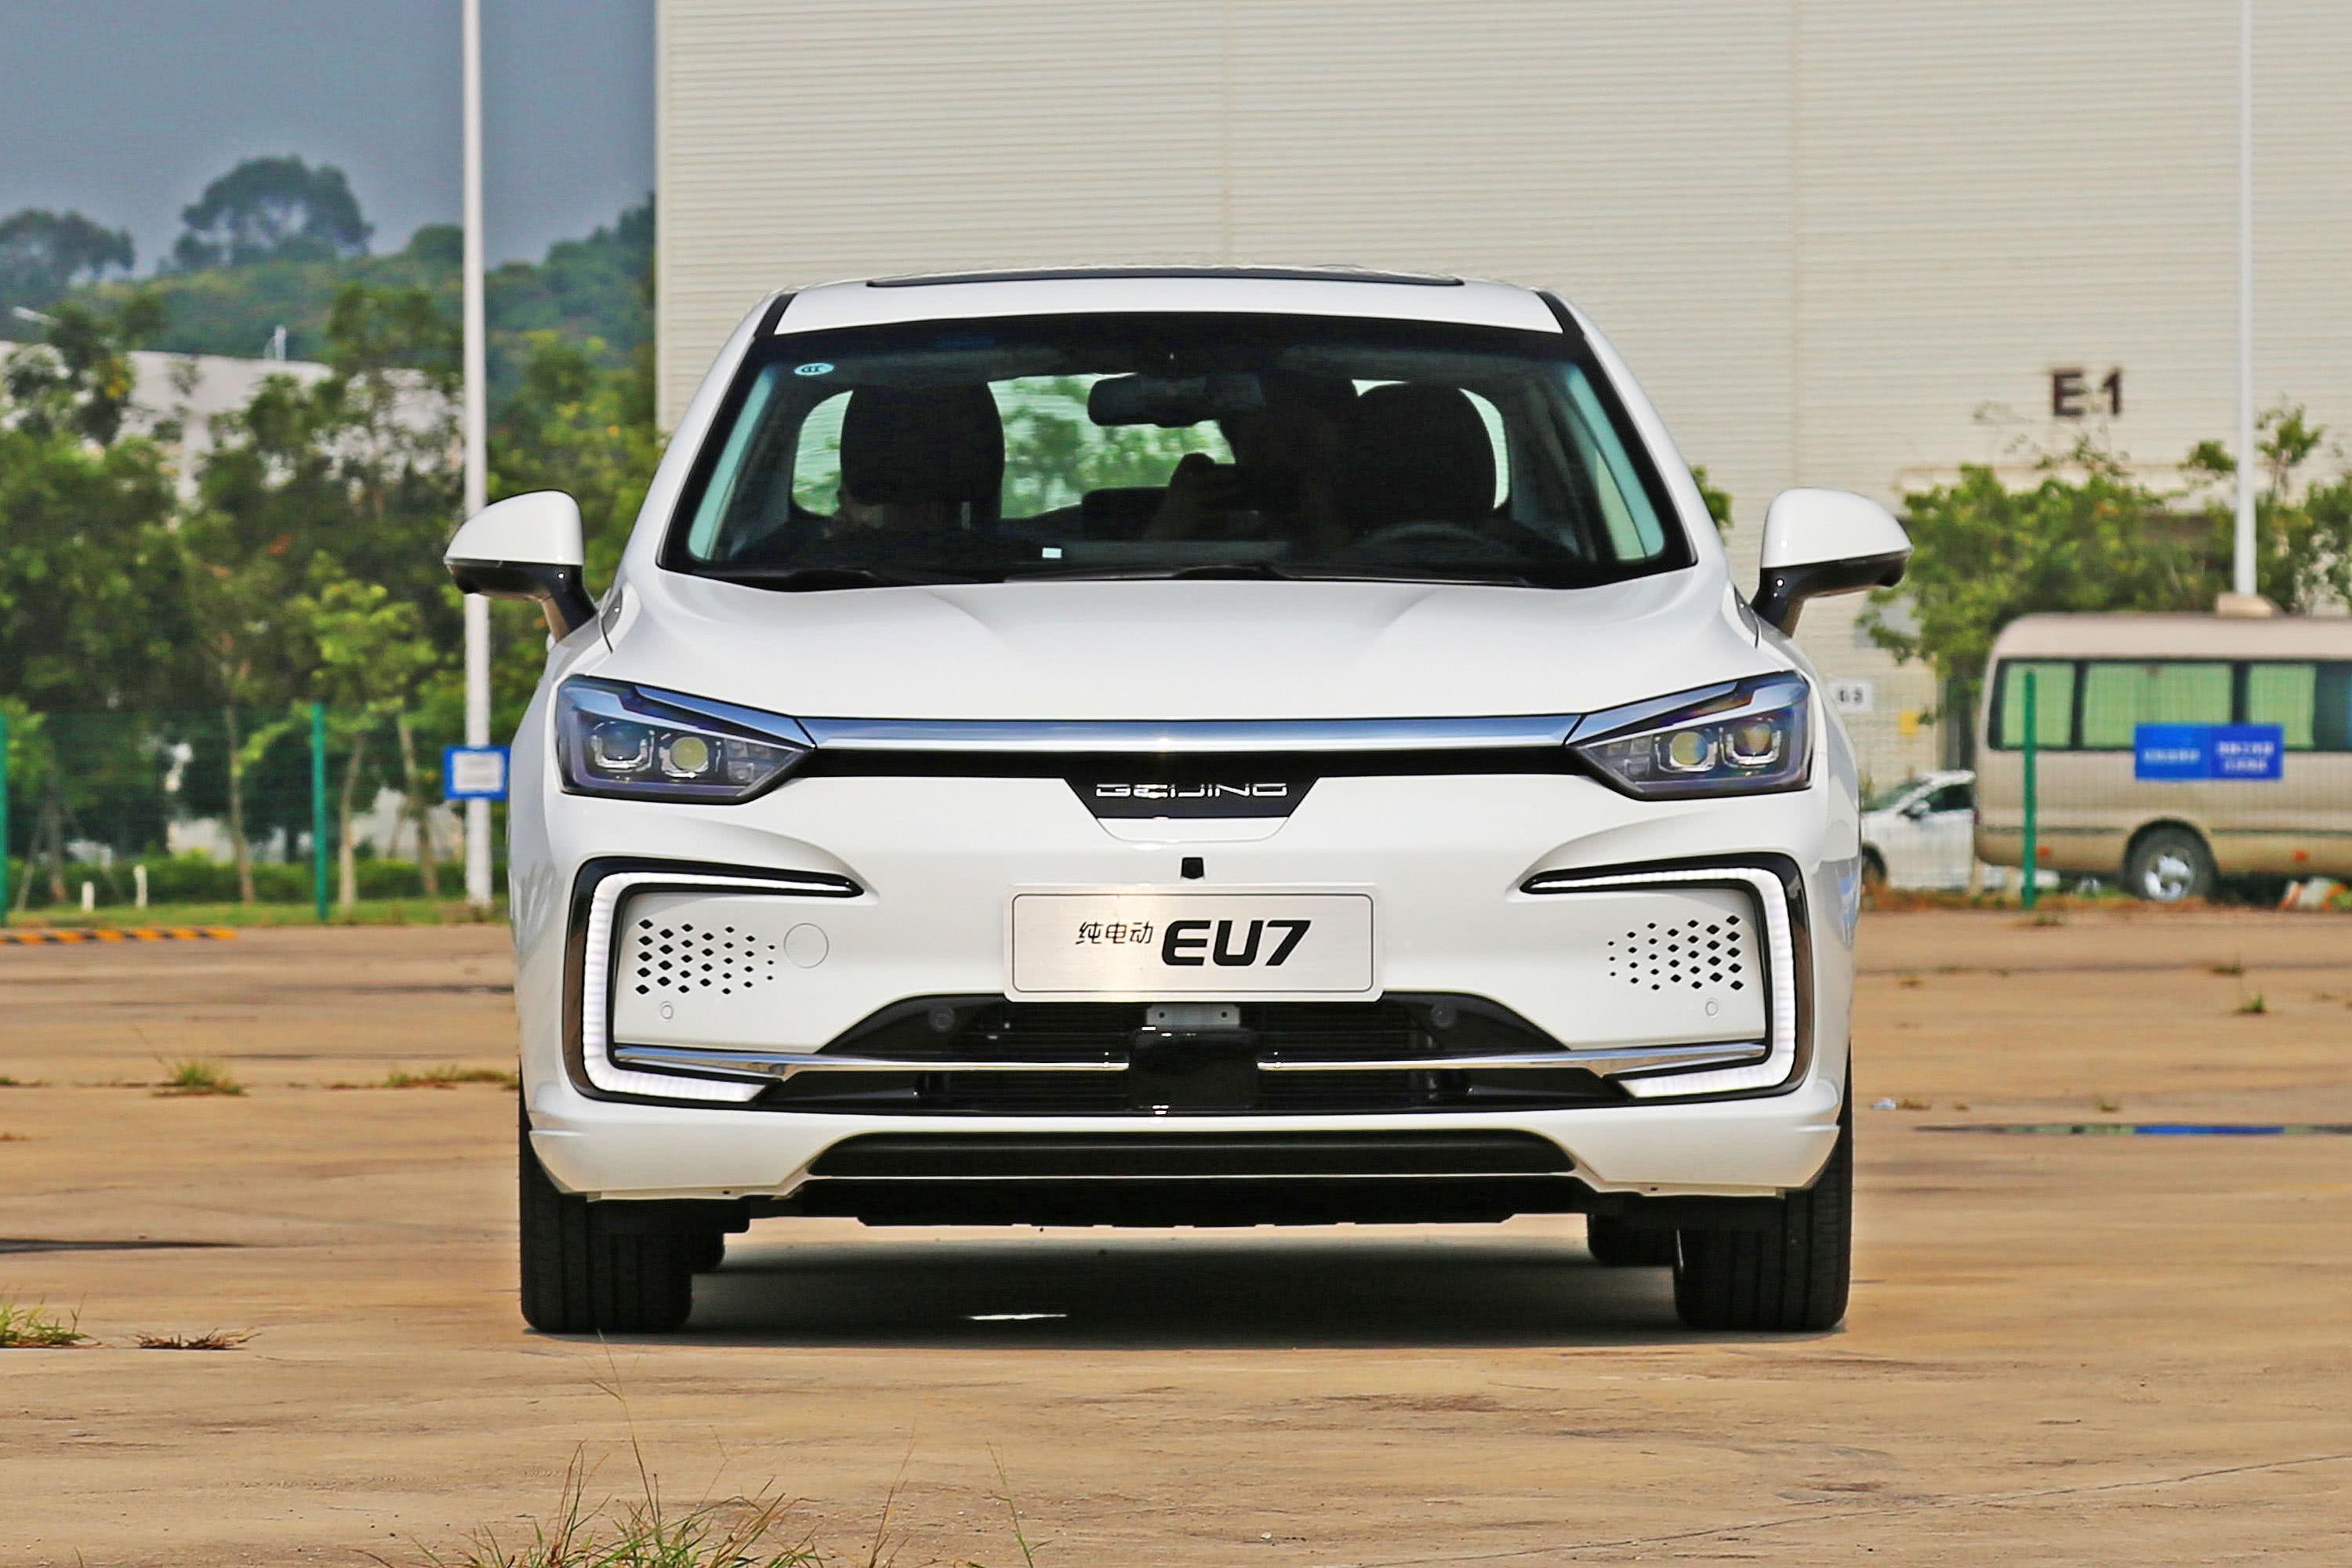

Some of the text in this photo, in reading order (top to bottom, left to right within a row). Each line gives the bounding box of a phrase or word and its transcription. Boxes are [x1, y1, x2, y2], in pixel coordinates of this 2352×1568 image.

[2051, 367, 2122, 416] E1
[1095, 783, 1287, 798] BEIJING
[1076, 920, 1312, 967] 纯电动 EU7
